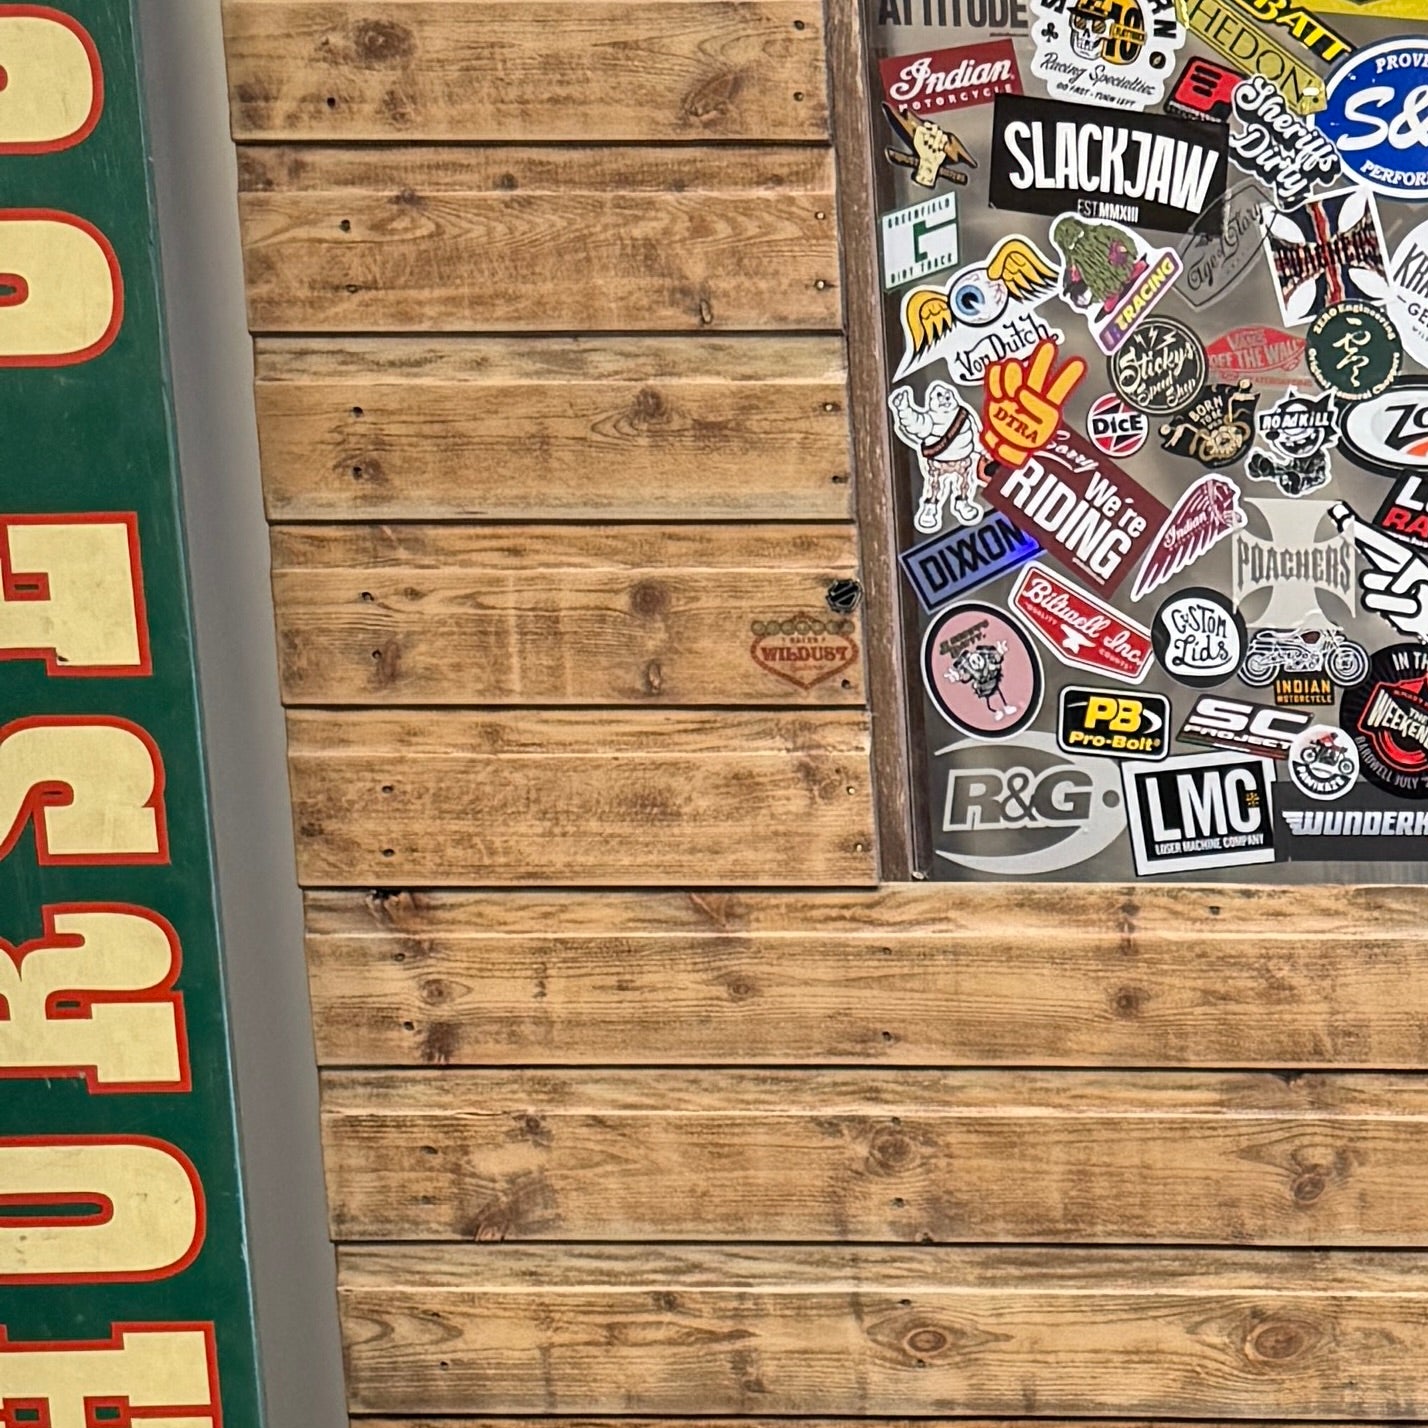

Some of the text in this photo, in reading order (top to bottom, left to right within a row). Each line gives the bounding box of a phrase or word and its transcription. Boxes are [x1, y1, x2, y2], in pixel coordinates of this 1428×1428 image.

[889, 57, 1014, 100] Indian
[1040, 52, 1088, 84] Racing
[1003, 120, 1219, 214] SLACKJAW
[887, 197, 950, 230] GREENFIELD
[1236, 347, 1264, 369] THE
[991, 405, 1040, 445] DTRA
[1000, 457, 1132, 580] RIDING
[918, 518, 1029, 594] DIXXON
[1237, 535, 1351, 594] POACHERS
[1392, 651, 1410, 671] IN
[1276, 679, 1331, 694] INDIAN
[1276, 693, 1333, 704] MOTORCYCLE
[1084, 696, 1144, 733] PB
[1188, 698, 1309, 742] SC
[1182, 724, 1294, 750] PROJECT
[946, 768, 1094, 830] R&G
[1394, 773, 1419, 790] JULY
[1145, 768, 1262, 844] LMC
[1182, 838, 1222, 853] MACHINE
[1223, 833, 1265, 849] COMPANY
